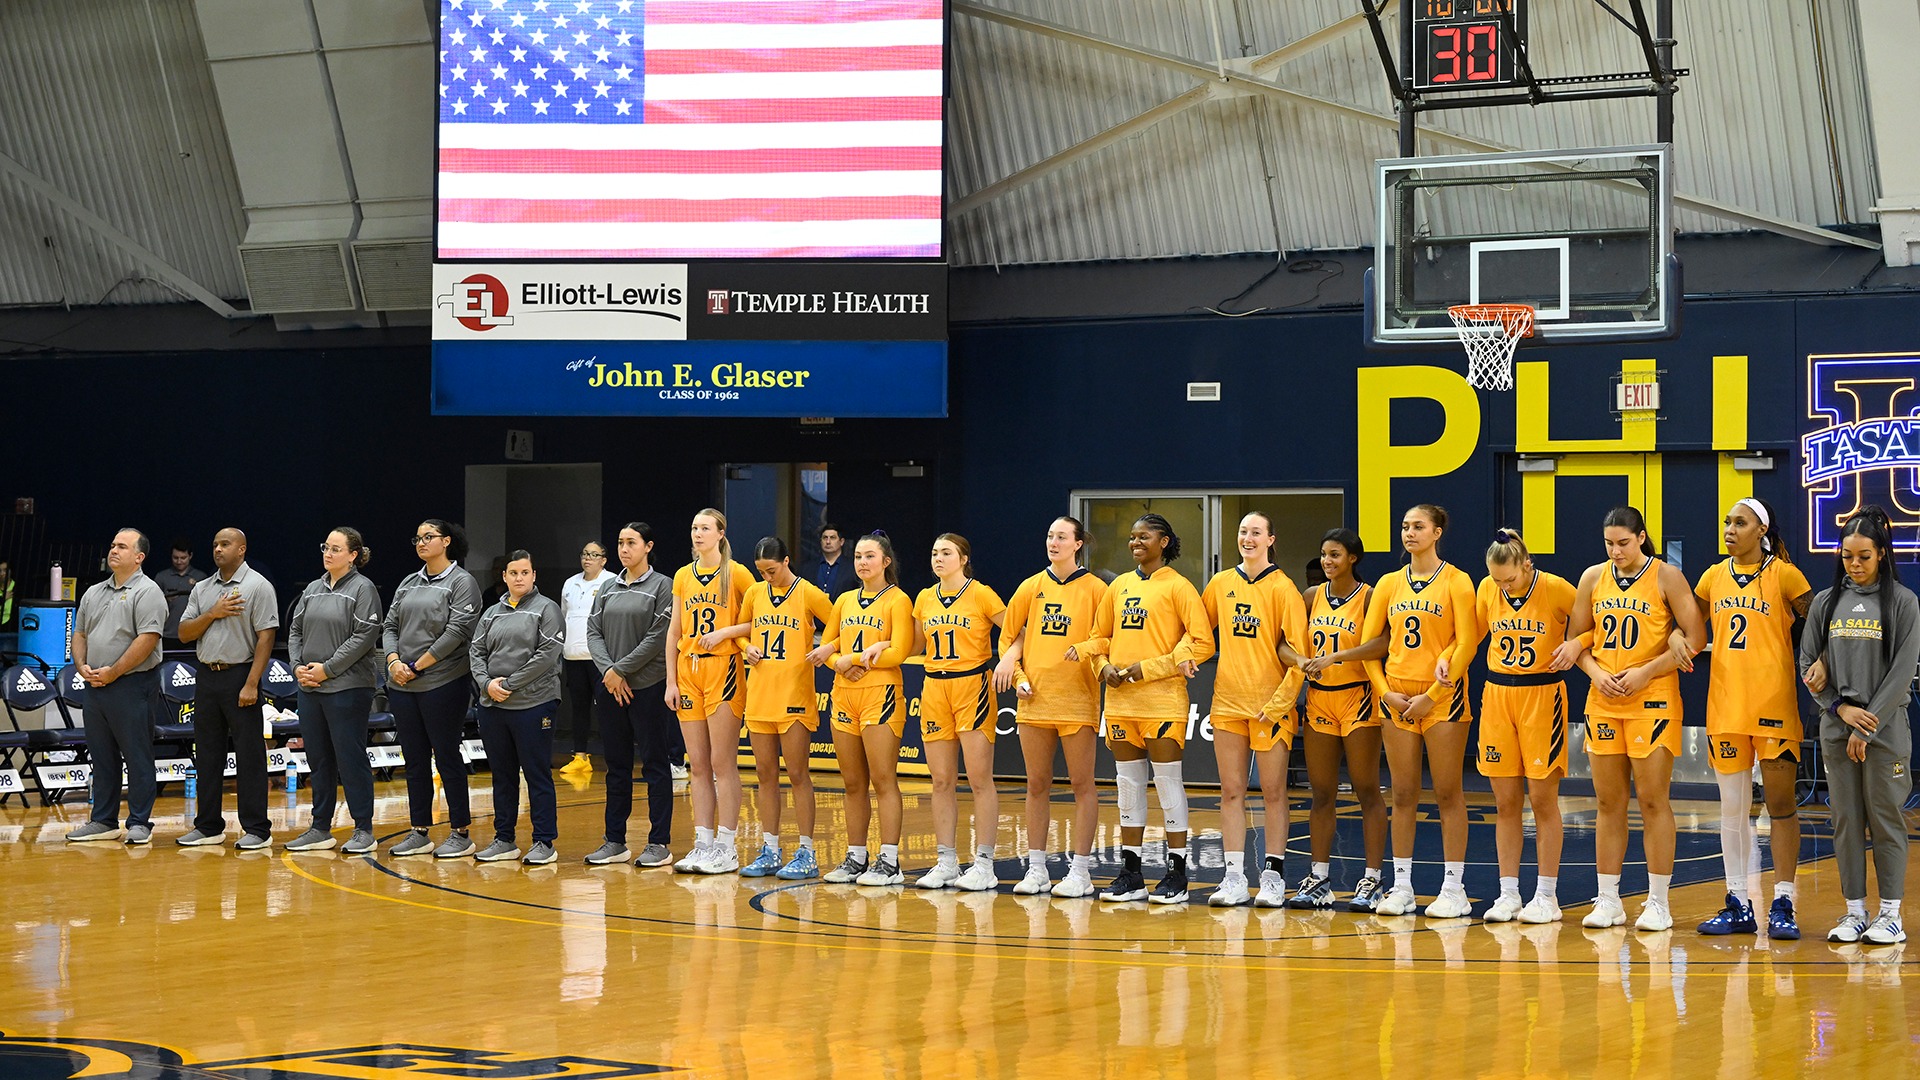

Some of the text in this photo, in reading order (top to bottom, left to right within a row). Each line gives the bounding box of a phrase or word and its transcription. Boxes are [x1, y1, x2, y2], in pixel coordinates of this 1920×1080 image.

[1432, 25, 1496, 82] 30
[522, 283, 682, 305] Elliott-Lewis
[731, 291, 929, 313] TEMPLE HEALTH
[566, 356, 597, 371] Gift of
[588, 362, 810, 388] John E. Glaser
[658, 390, 739, 401] CLASS OF 1962
[1625, 385, 1651, 407] EXIT
[1357, 356, 1753, 554] PHI
[1390, 600, 1442, 617] LASALLE
[1595, 598, 1650, 616] LASALLE
[1714, 596, 1770, 616] LASALLE
[689, 607, 716, 638] 13
[754, 614, 800, 631] LASALLE
[923, 614, 971, 631] LASALLE
[1404, 615, 1422, 649] 3
[1492, 618, 1546, 635] LASALLE
[1602, 614, 1639, 650] 20
[1729, 614, 1747, 650] 2
[1846, 619, 1882, 631] SALL
[760, 629, 786, 660] 14
[851, 629, 864, 653] 4
[931, 629, 960, 661] 11
[1313, 630, 1343, 665] 21
[1500, 636, 1536, 668] 25
[16, 682, 46, 692] adidas
[171, 677, 196, 687] adida
[268, 674, 294, 683] adidas
[172, 763, 186, 775] 98
[269, 753, 285, 766] 98
[69, 770, 86, 781] 98
